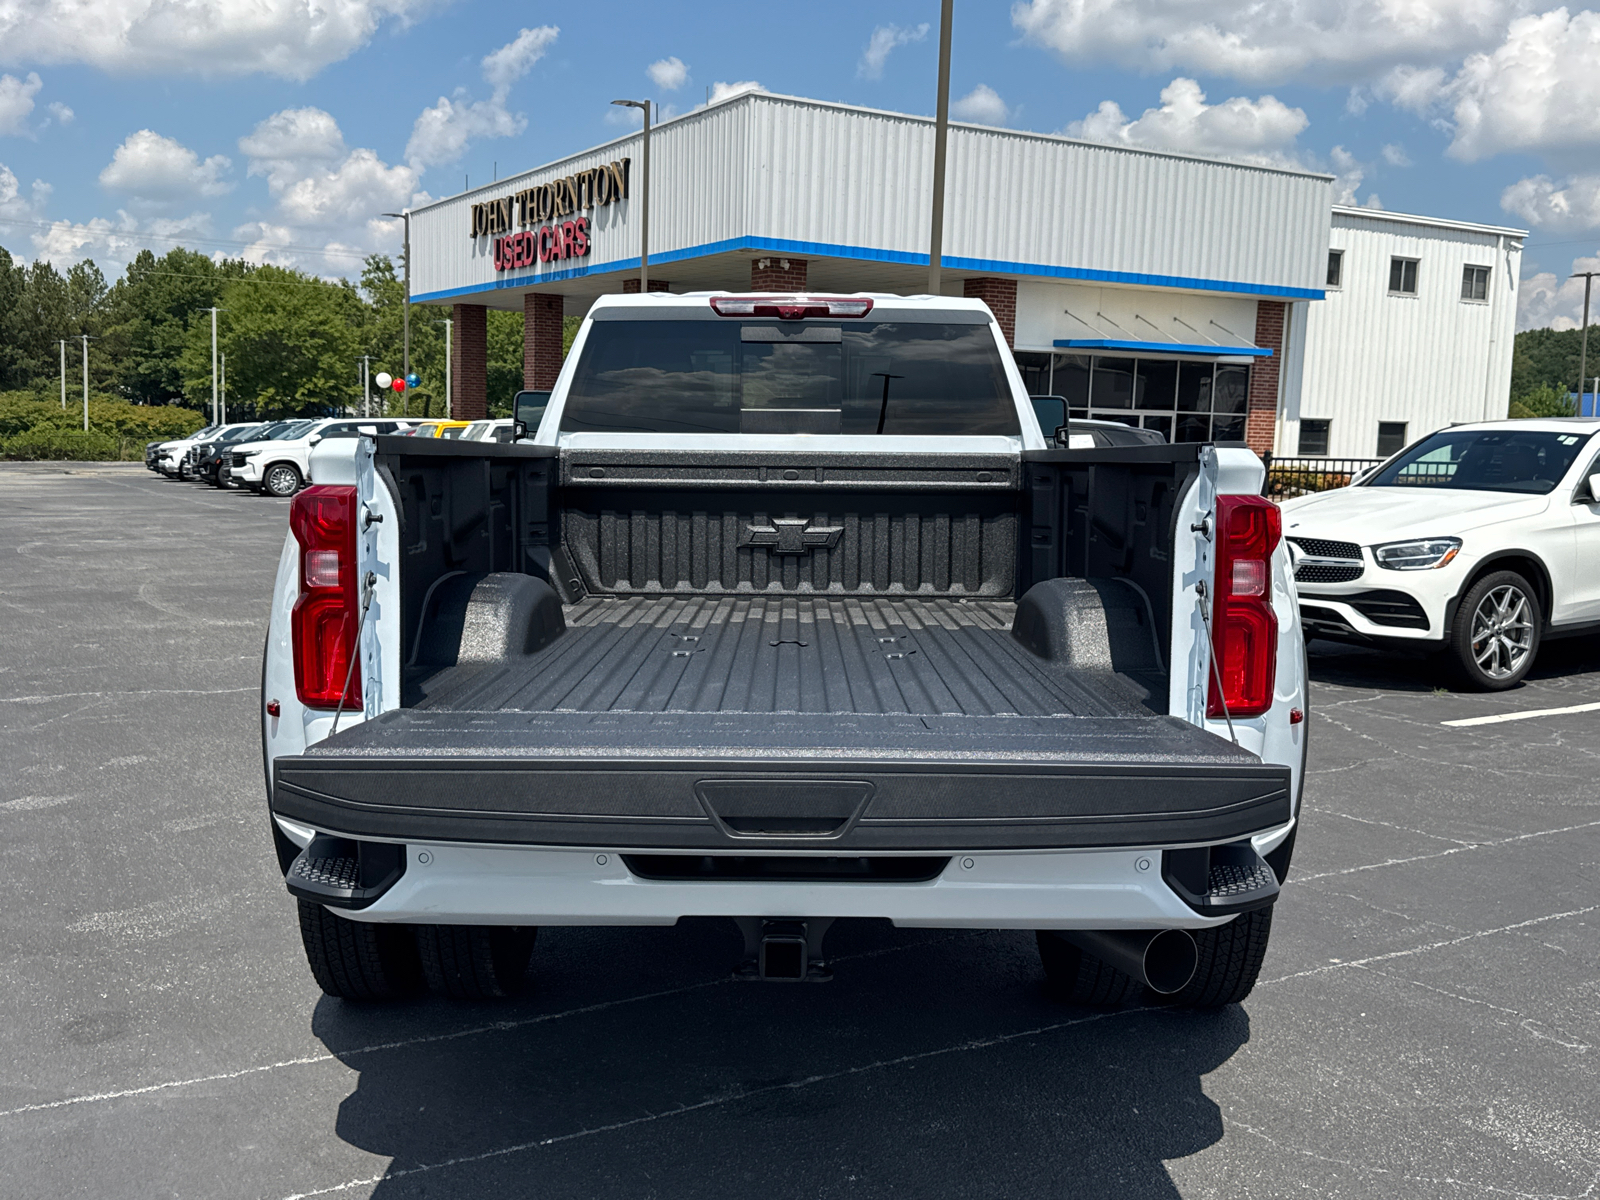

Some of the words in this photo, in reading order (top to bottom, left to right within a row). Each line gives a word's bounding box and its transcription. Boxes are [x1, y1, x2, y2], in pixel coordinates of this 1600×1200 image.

[470, 196, 514, 238] JOHN
[515, 158, 630, 227] THORNTON
[493, 231, 537, 272] USED
[538, 217, 590, 263] CARS
